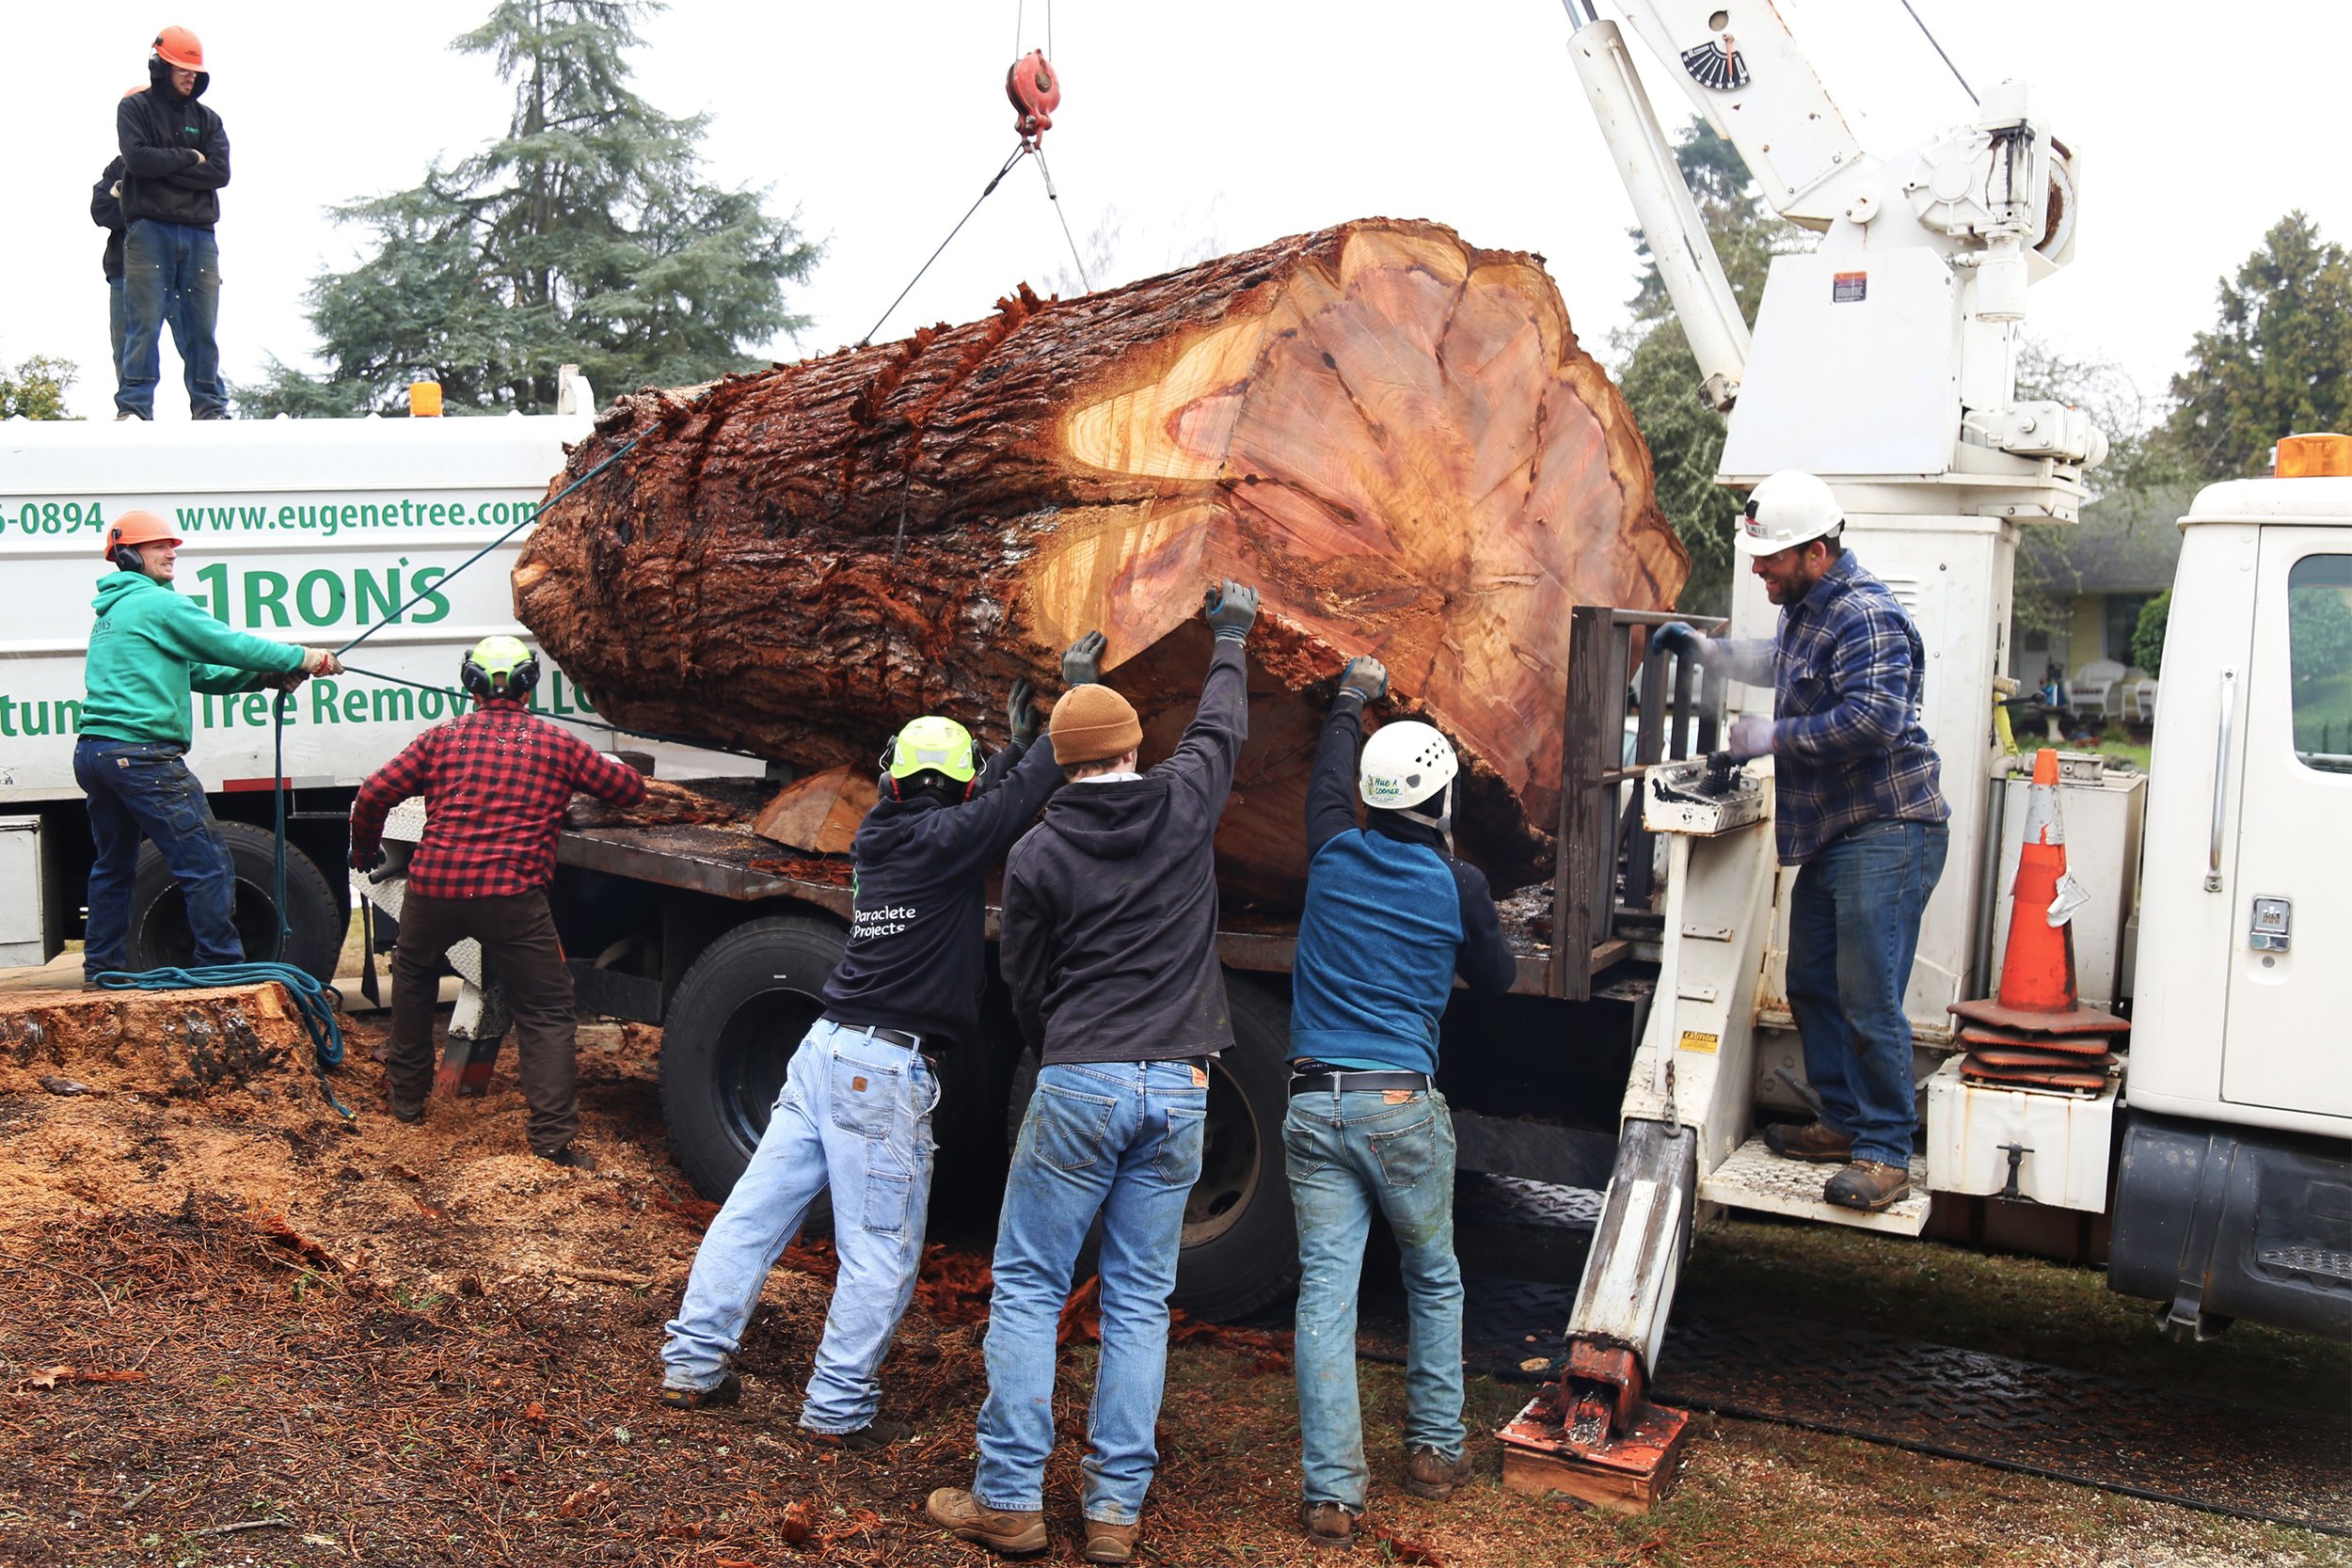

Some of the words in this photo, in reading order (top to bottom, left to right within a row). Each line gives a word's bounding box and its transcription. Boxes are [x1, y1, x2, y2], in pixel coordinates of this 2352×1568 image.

[176, 499, 540, 536] www.eugenetree.com
[311, 678, 480, 724] Remov
[854, 905, 916, 924] Paraclete
[853, 922, 905, 940] Projects
[1684, 1031, 1717, 1042] CAUTION
